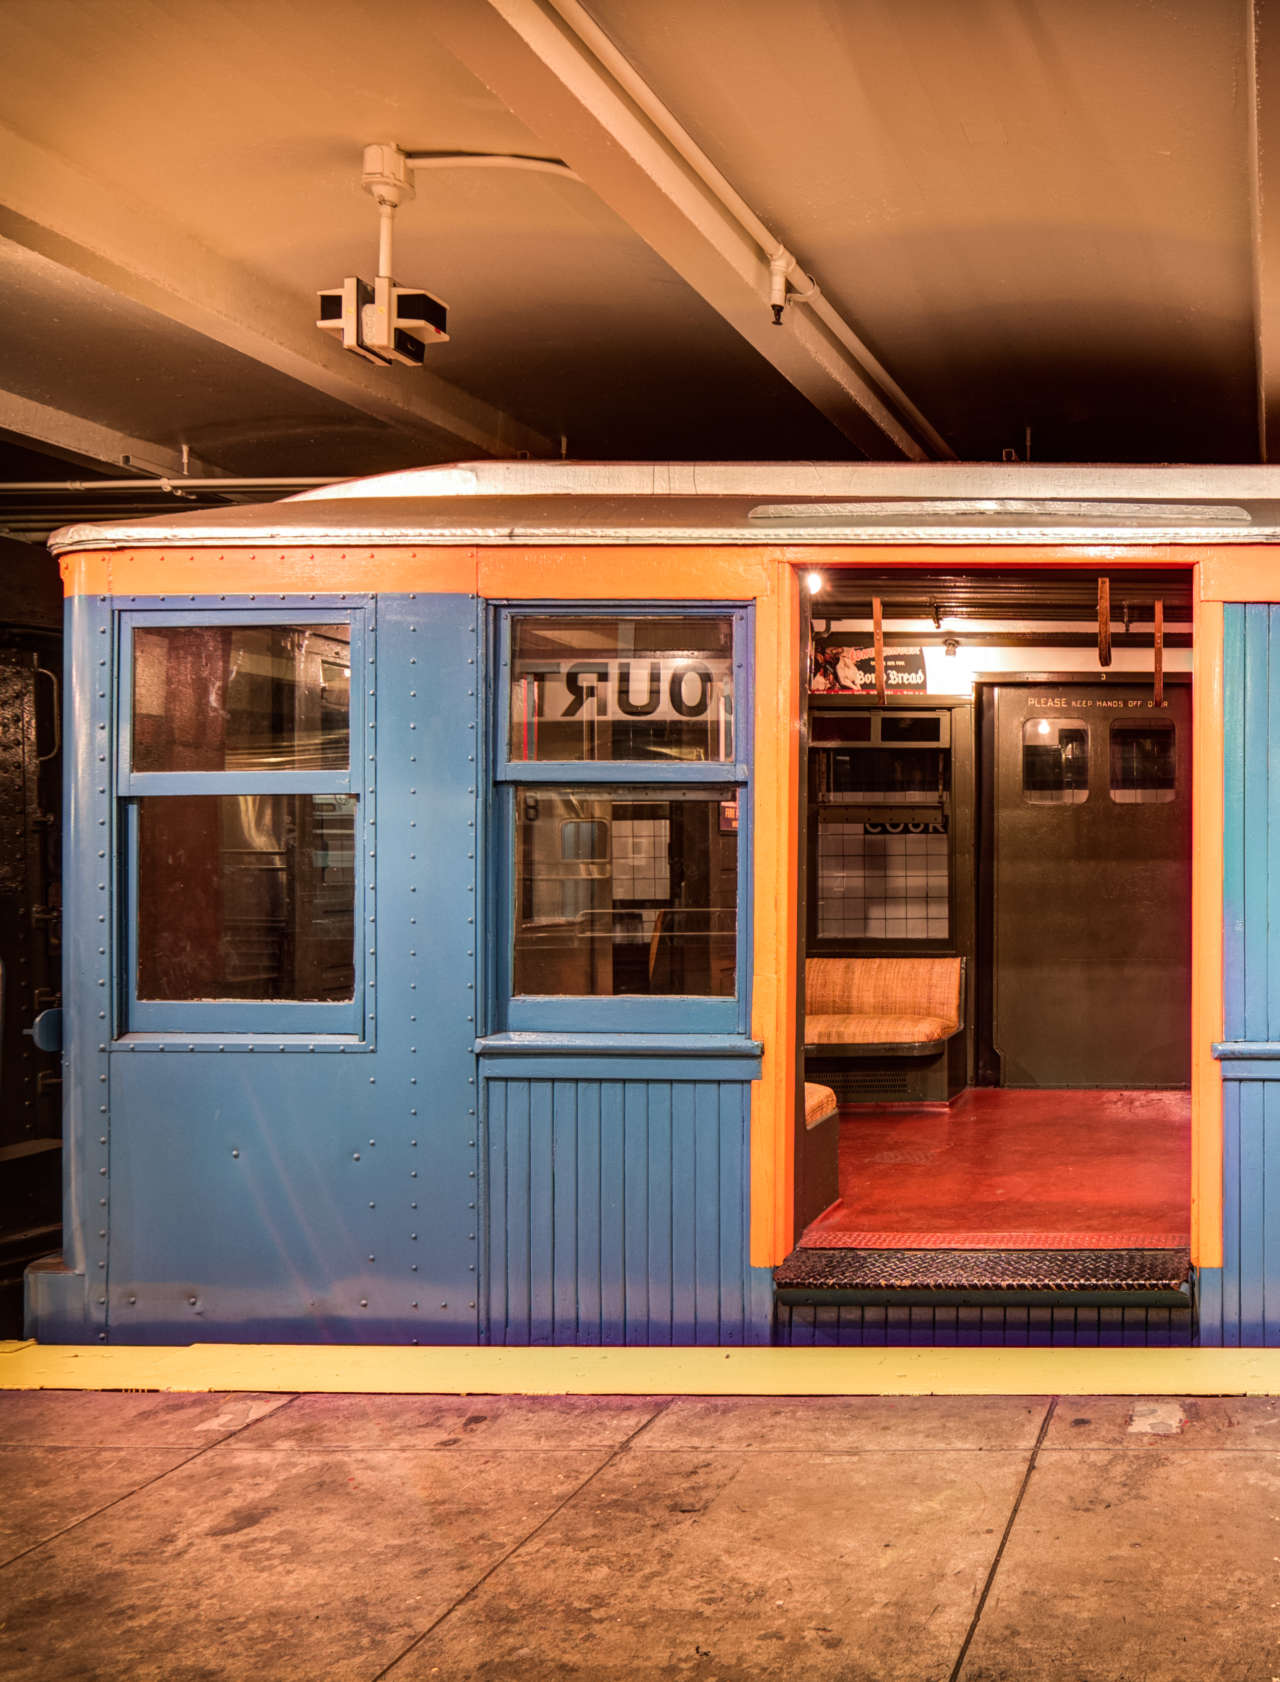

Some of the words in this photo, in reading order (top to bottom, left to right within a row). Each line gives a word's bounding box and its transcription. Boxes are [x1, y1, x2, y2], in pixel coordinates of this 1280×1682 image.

[887, 669, 925, 685] Bread
[1028, 697, 1068, 708] PLEASE
[1071, 700, 1093, 708] KEEP
[1096, 700, 1124, 708] HANDS
[1127, 700, 1142, 708] OFF
[1147, 700, 1168, 708] DR
